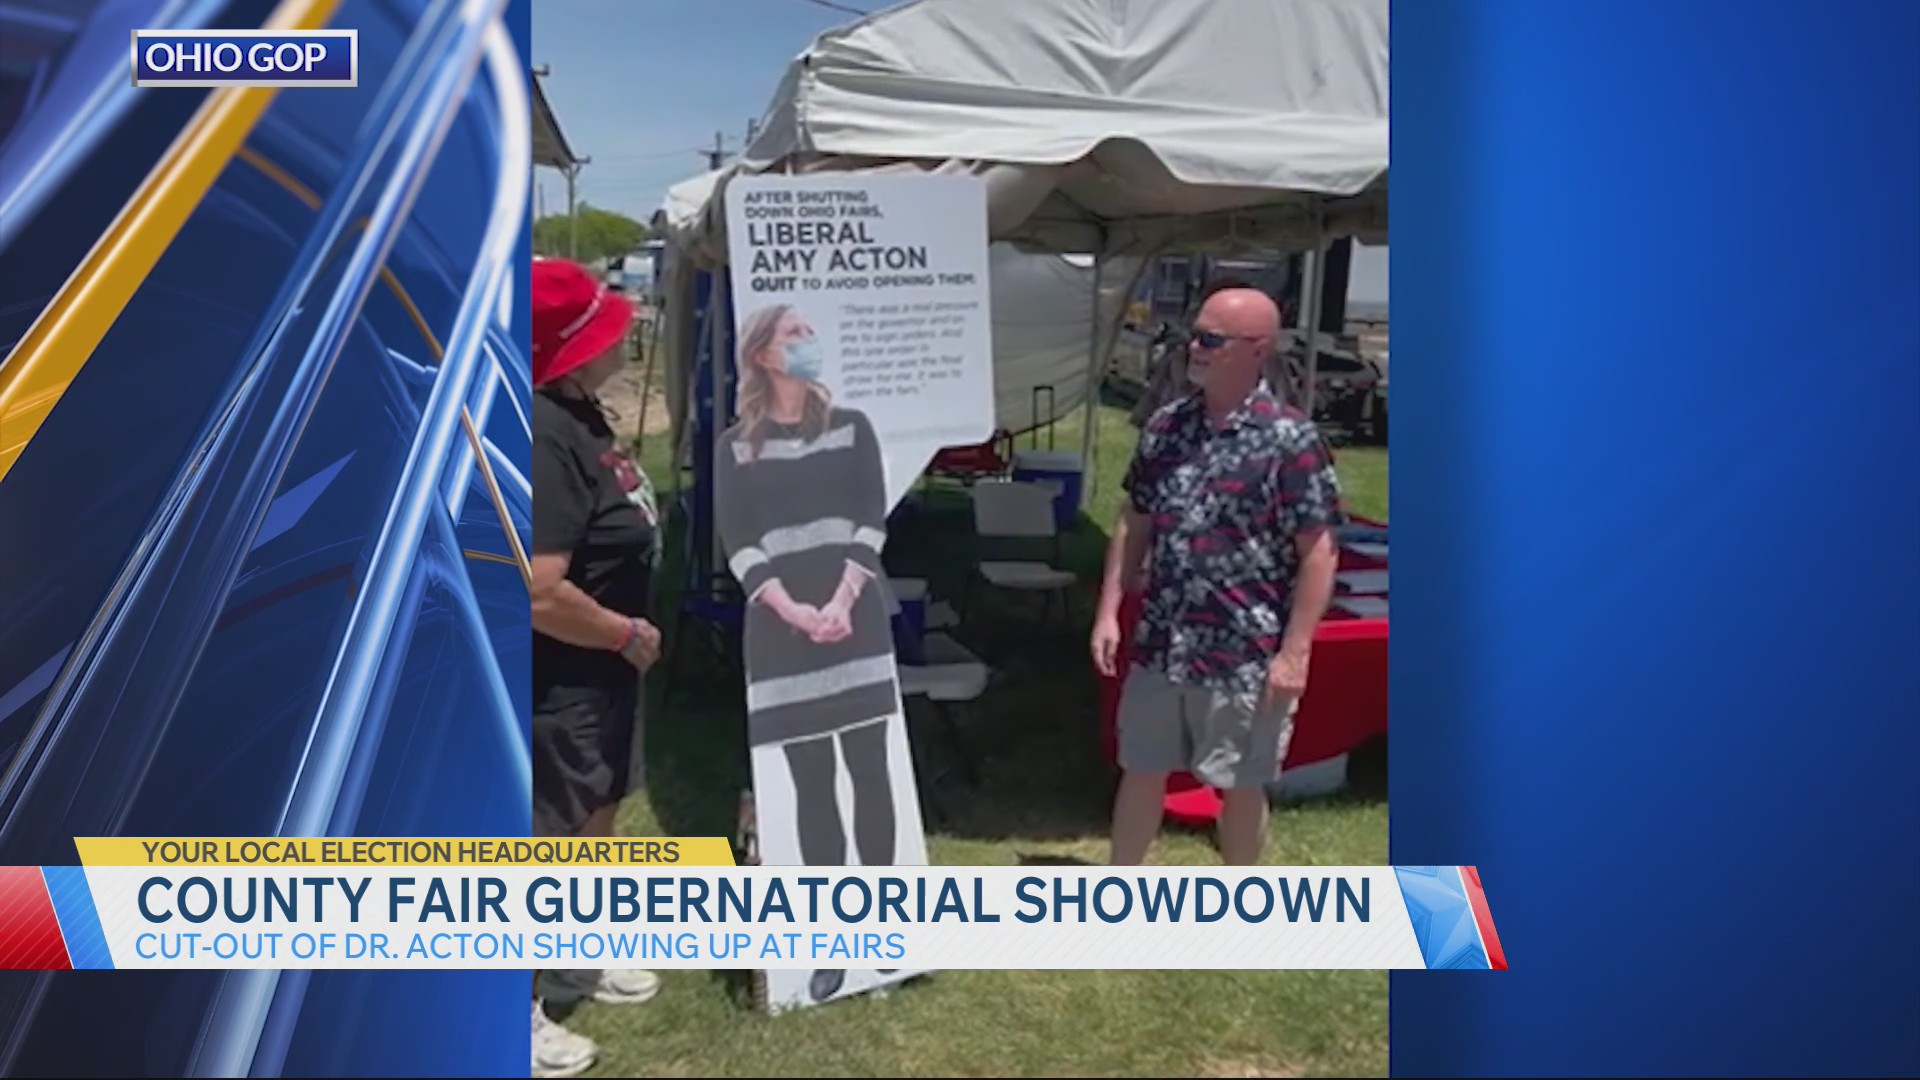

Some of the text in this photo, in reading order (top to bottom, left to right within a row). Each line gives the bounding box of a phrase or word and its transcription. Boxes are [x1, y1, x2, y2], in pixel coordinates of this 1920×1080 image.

[744, 192, 867, 204] AFTER SHUTTING
[745, 206, 794, 218] DOWN
[798, 206, 835, 218] OHIO
[749, 222, 874, 246] LIBERAL
[751, 247, 927, 273] AMY ACTON
[752, 277, 797, 292] QUIT
[803, 278, 821, 289] TO
[825, 276, 868, 289] AVOID
[873, 275, 934, 288] OPENING
